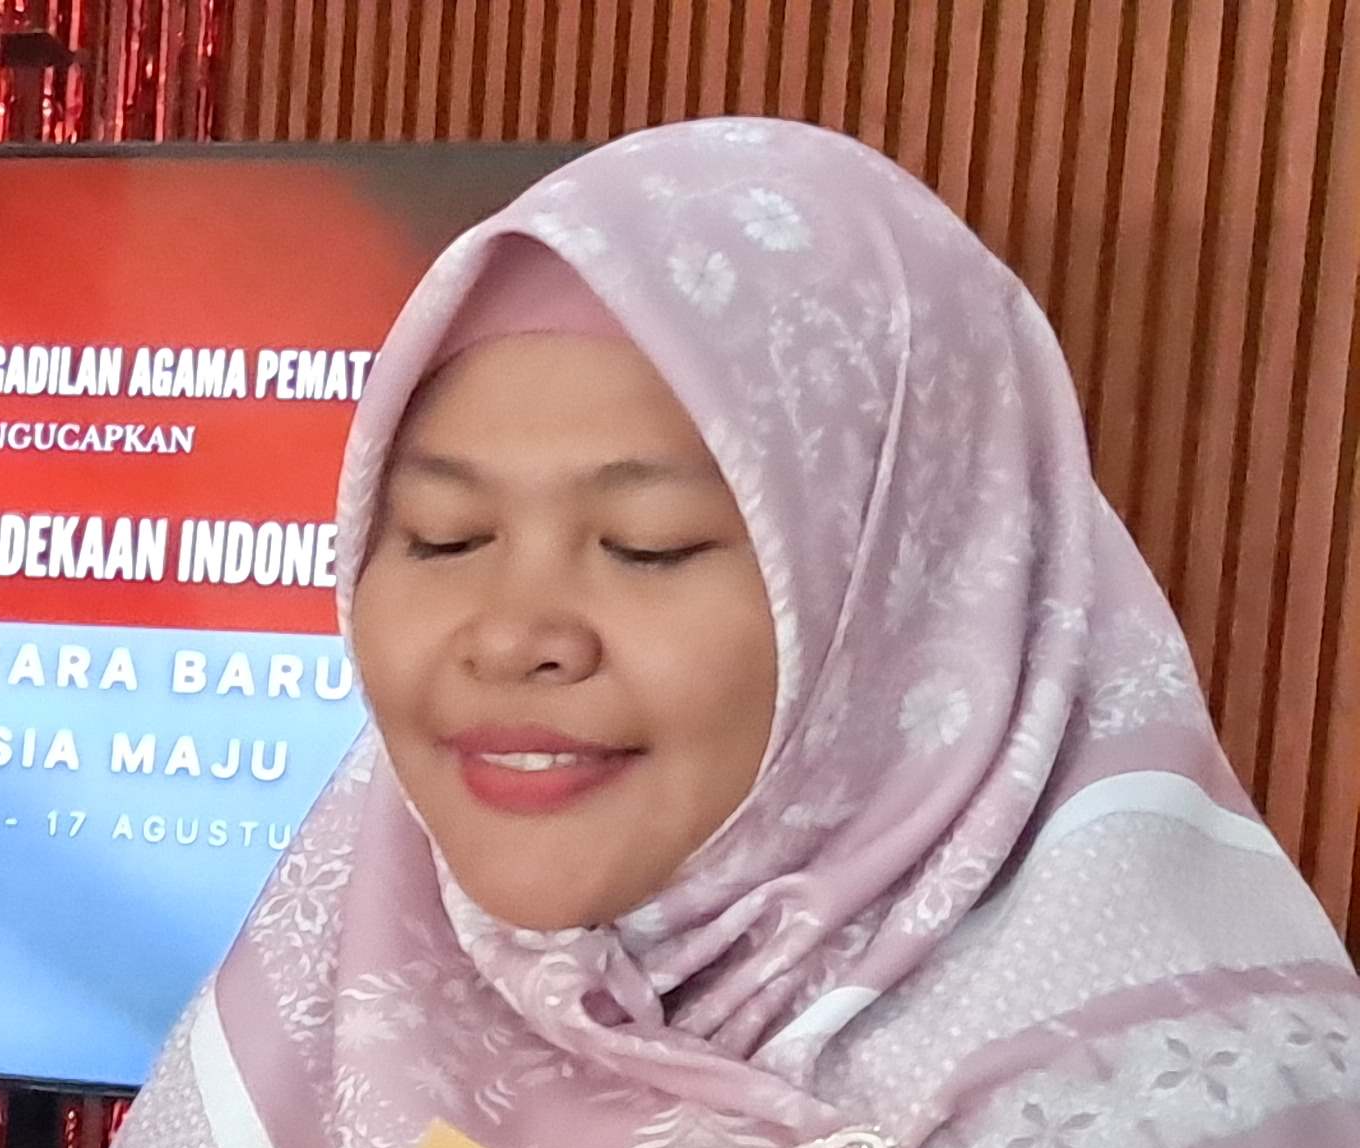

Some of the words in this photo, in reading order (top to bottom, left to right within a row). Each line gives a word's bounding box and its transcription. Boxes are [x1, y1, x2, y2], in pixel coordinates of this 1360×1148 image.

[128, 347, 247, 399] AGAMA
[255, 350, 380, 401] PEMAT
[177, 519, 338, 588] INDONE
[171, 649, 353, 701] BARU
[110, 732, 289, 782] MAJU
[46, 810, 88, 838] 17
[111, 814, 293, 851] AGUSTU
